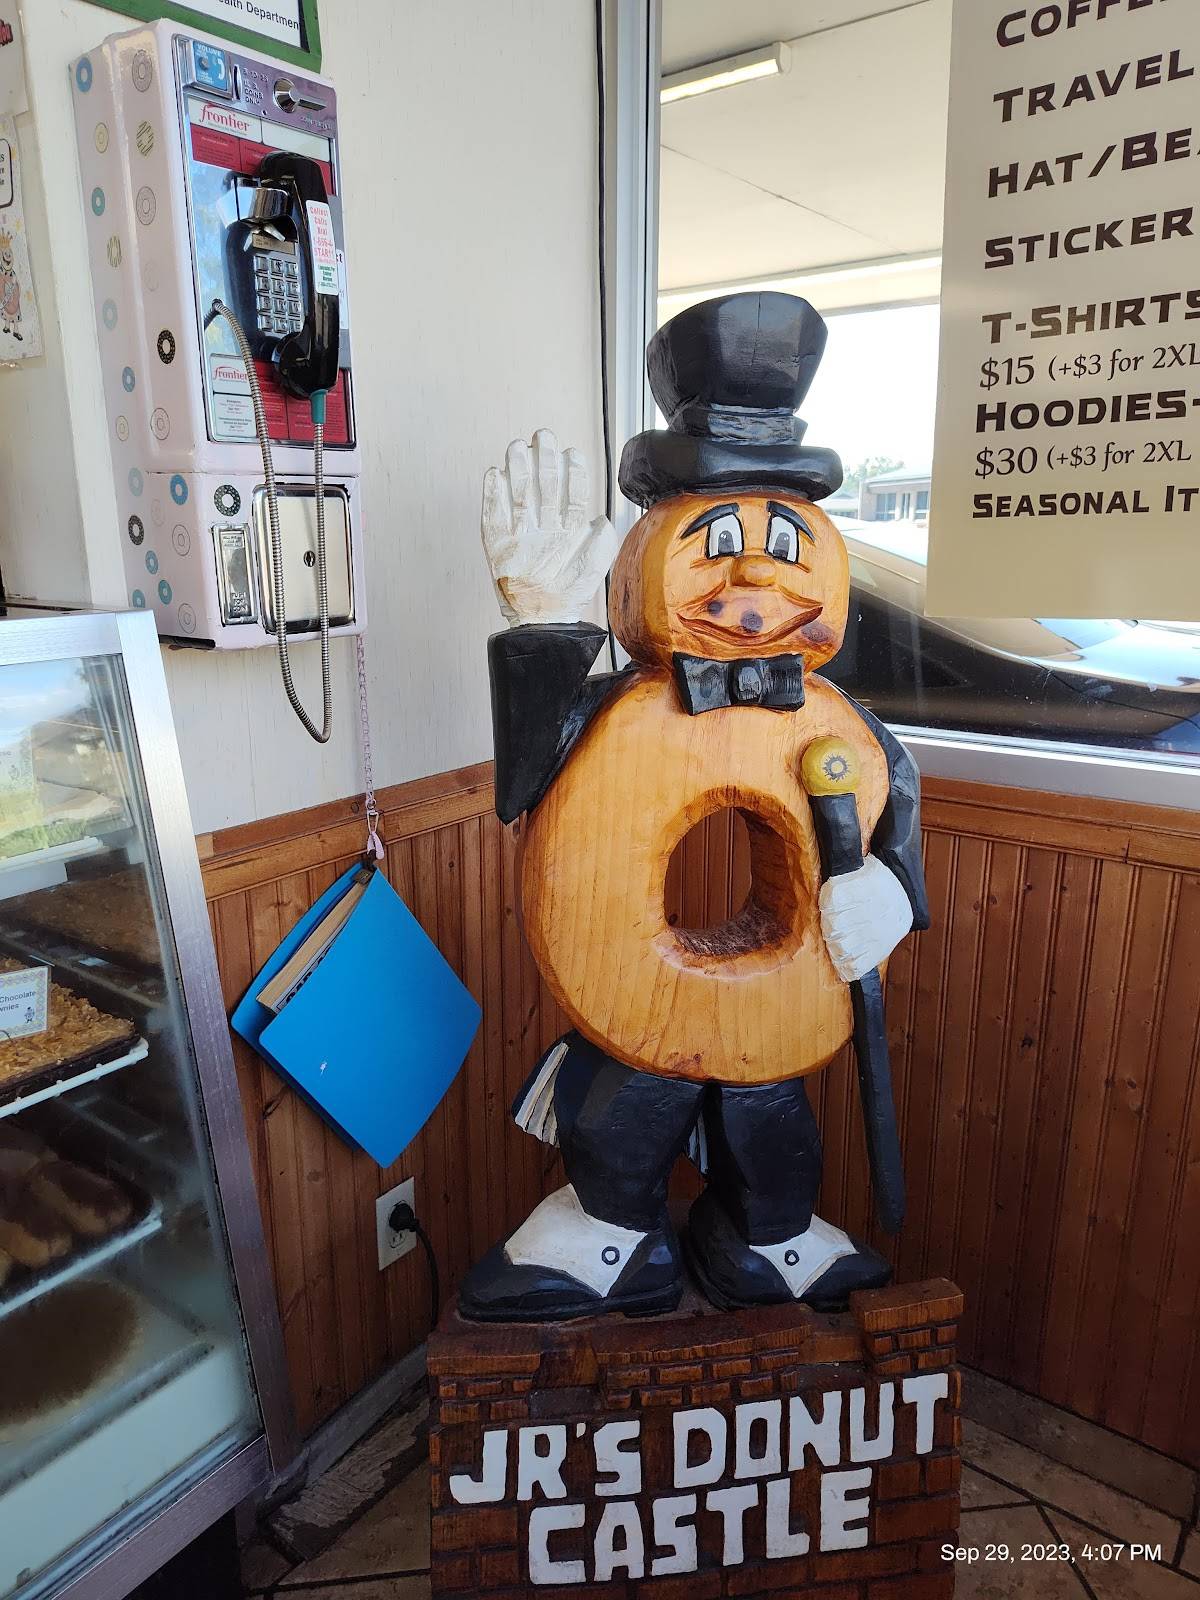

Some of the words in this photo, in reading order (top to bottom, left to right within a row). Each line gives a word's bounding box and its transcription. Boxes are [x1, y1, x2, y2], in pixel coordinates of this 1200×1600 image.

[246, 2, 301, 30] Departmen
[993, 49, 1195, 123] TRAVEL
[200, 103, 250, 132] frontier
[988, 127, 1200, 198] HAT/BE
[984, 206, 1194, 269] STICKER
[980, 355, 1035, 390] $15
[1048, 354, 1102, 381] (+$3
[1107, 348, 1145, 381] for
[1152, 342, 1200, 369] 2XL
[975, 446, 1038, 479] $30
[1046, 444, 1096, 470] (+$3
[1102, 441, 1135, 472] for
[1142, 440, 1192, 463] 2XL
[972, 489, 1150, 518] SEASONAL
[450, 1420, 642, 1504] JR'S
[673, 1373, 949, 1488] DONUT
[529, 1467, 872, 1585] CASTLE
